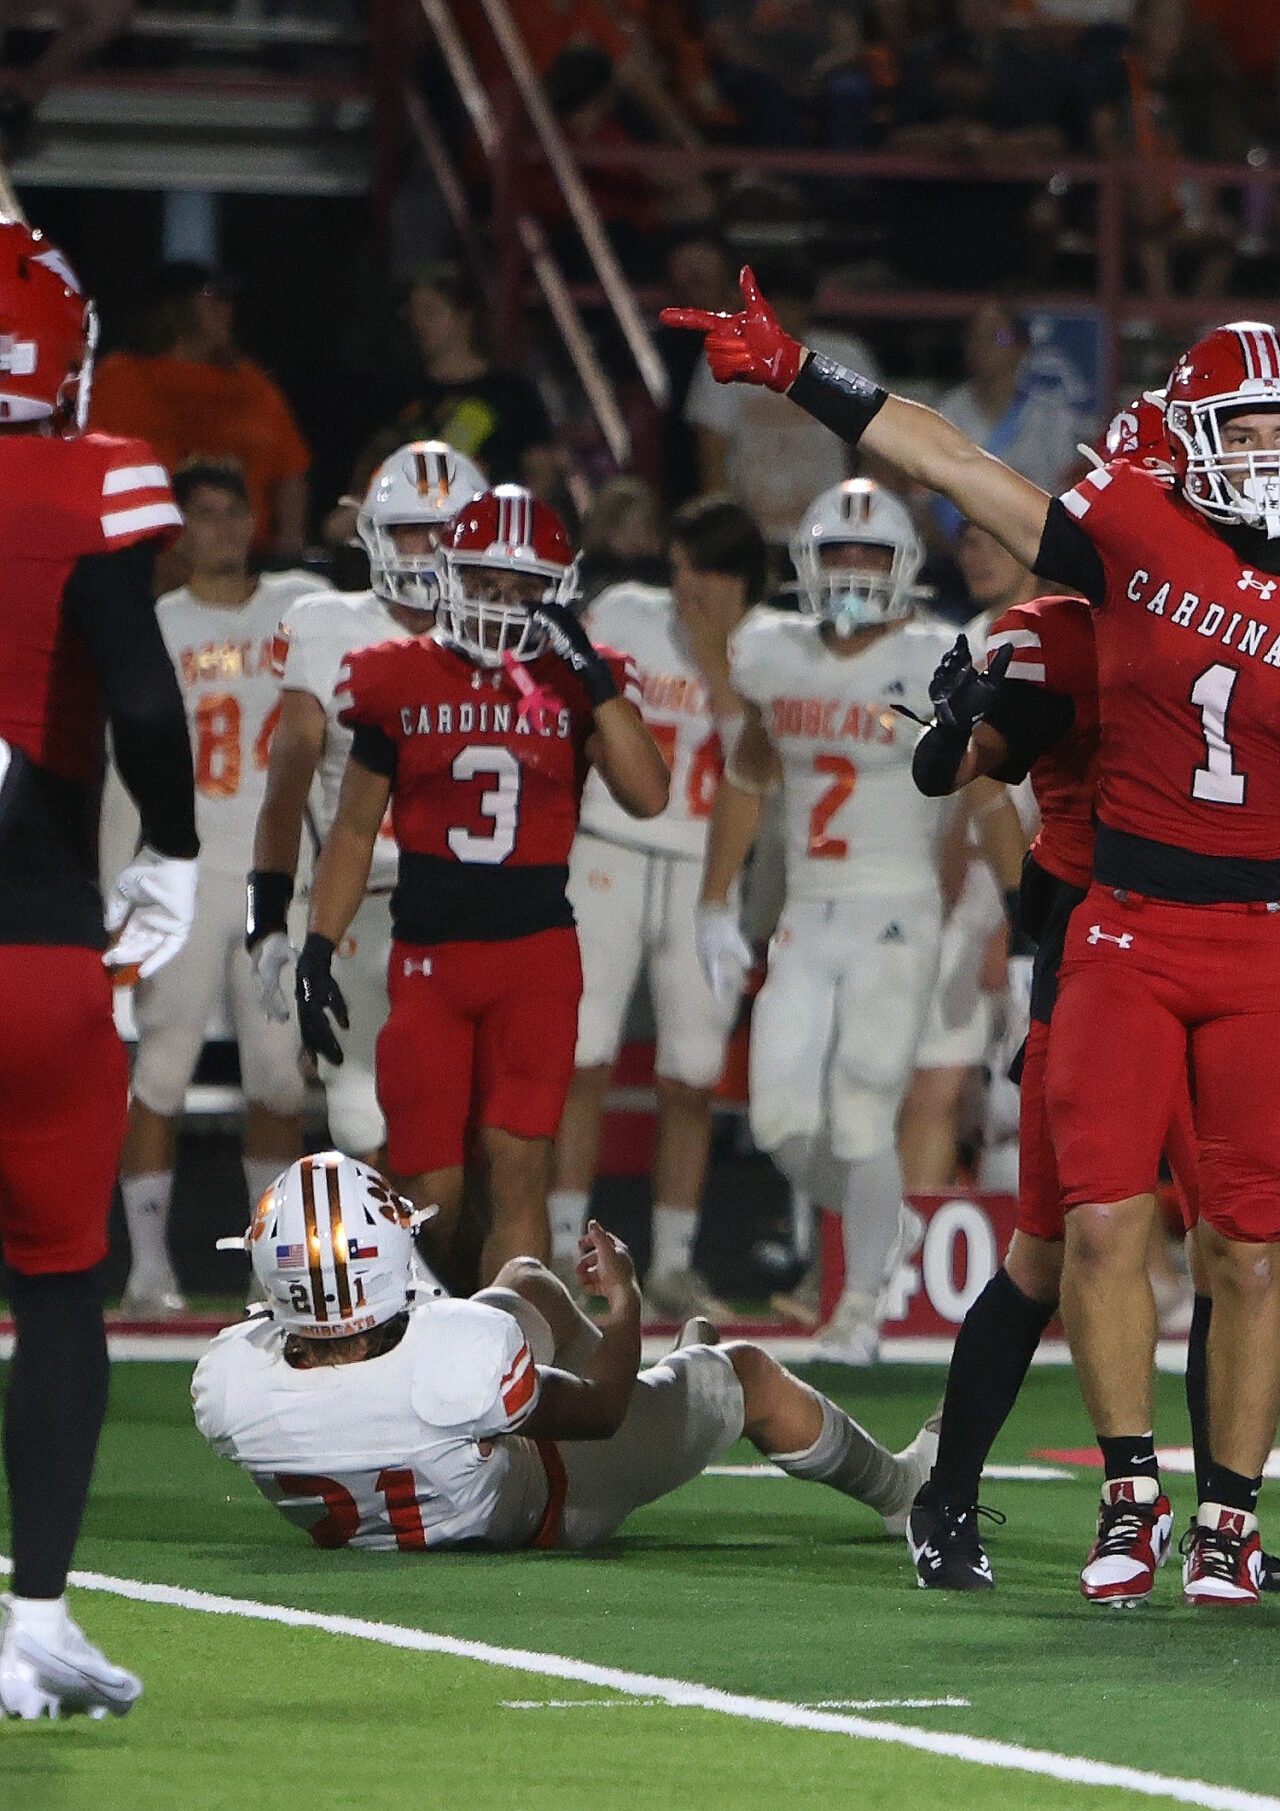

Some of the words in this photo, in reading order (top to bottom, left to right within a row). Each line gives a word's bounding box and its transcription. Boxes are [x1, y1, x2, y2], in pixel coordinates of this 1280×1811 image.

[1189, 662, 1246, 805] 1
[447, 743, 521, 865] 3
[808, 755, 857, 858] 2
